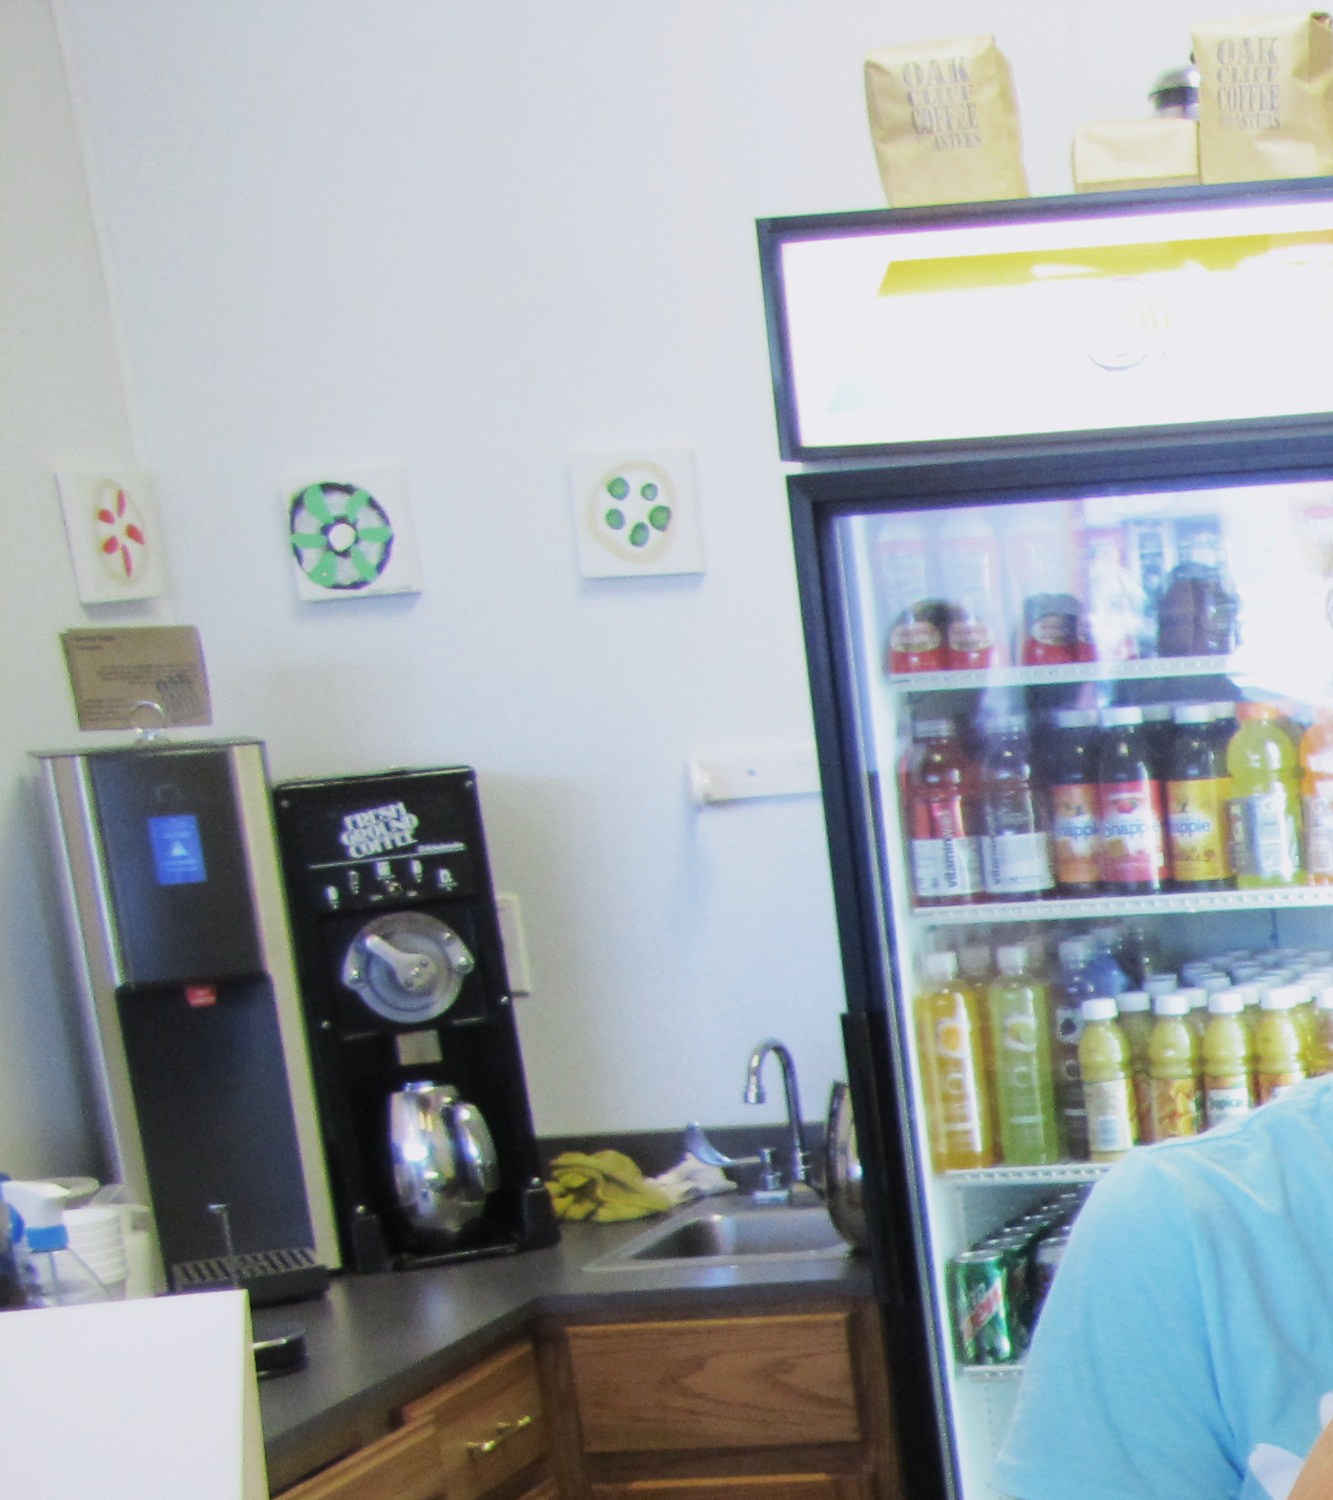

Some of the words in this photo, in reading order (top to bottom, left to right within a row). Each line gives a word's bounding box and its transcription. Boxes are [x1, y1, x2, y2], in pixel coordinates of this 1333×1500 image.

[1216, 37, 1278, 65] OAK
[902, 57, 972, 87] OAK
[1217, 84, 1280, 112] COFFEE
[911, 101, 980, 135] COFFEE
[343, 801, 408, 831] FRESH
[349, 831, 418, 859] COFFEE
